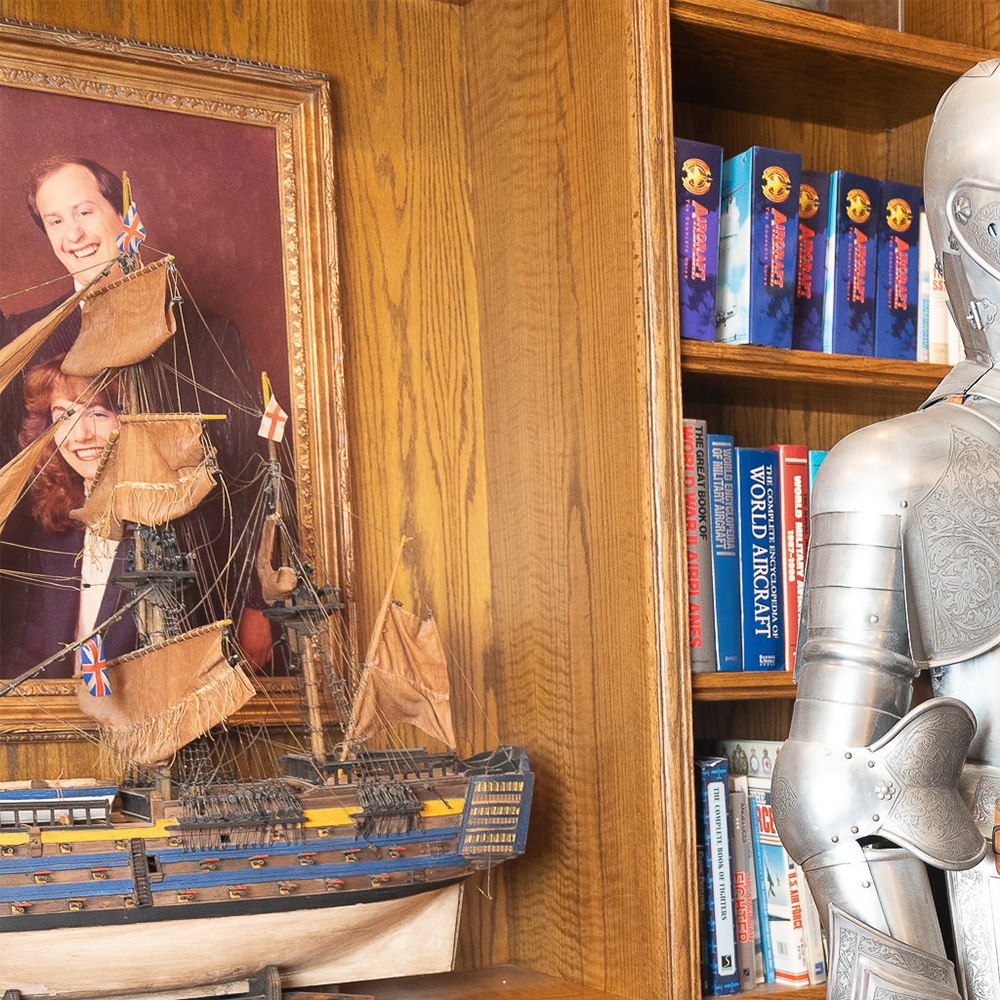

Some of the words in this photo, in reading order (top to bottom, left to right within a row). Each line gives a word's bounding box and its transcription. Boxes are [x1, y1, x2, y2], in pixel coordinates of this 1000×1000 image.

[692, 200, 709, 281] AIRCRAFT
[770, 207, 788, 288] AIRCRAFT
[797, 223, 815, 299] AIRCRAFT
[852, 227, 868, 304] AIRCRAFT
[894, 236, 910, 310] AIRCRAFT
[695, 426, 704, 448] THE
[712, 448, 723, 460] OF
[696, 450, 705, 489] GREAT
[712, 461, 724, 503] MILITARY
[723, 448, 733, 481] WORLD
[697, 490, 707, 522] BOOK
[724, 482, 735, 550] ENCYCLOPEDIA
[750, 465, 767, 539] WORLD
[767, 488, 775, 543] COMPLETE
[699, 528, 707, 540] OF
[714, 504, 727, 550] AIRCRAFT
[752, 543, 771, 638] AIRCRAFT
[769, 545, 778, 622] ENCYCLOPEDIA
[772, 625, 779, 638] OF
[719, 871, 724, 881] OF
[788, 873, 797, 887] U.S.
[790, 890, 800, 904] AIR
[735, 872, 748, 943] FIGHTER
[792, 905, 803, 930] FORCE
